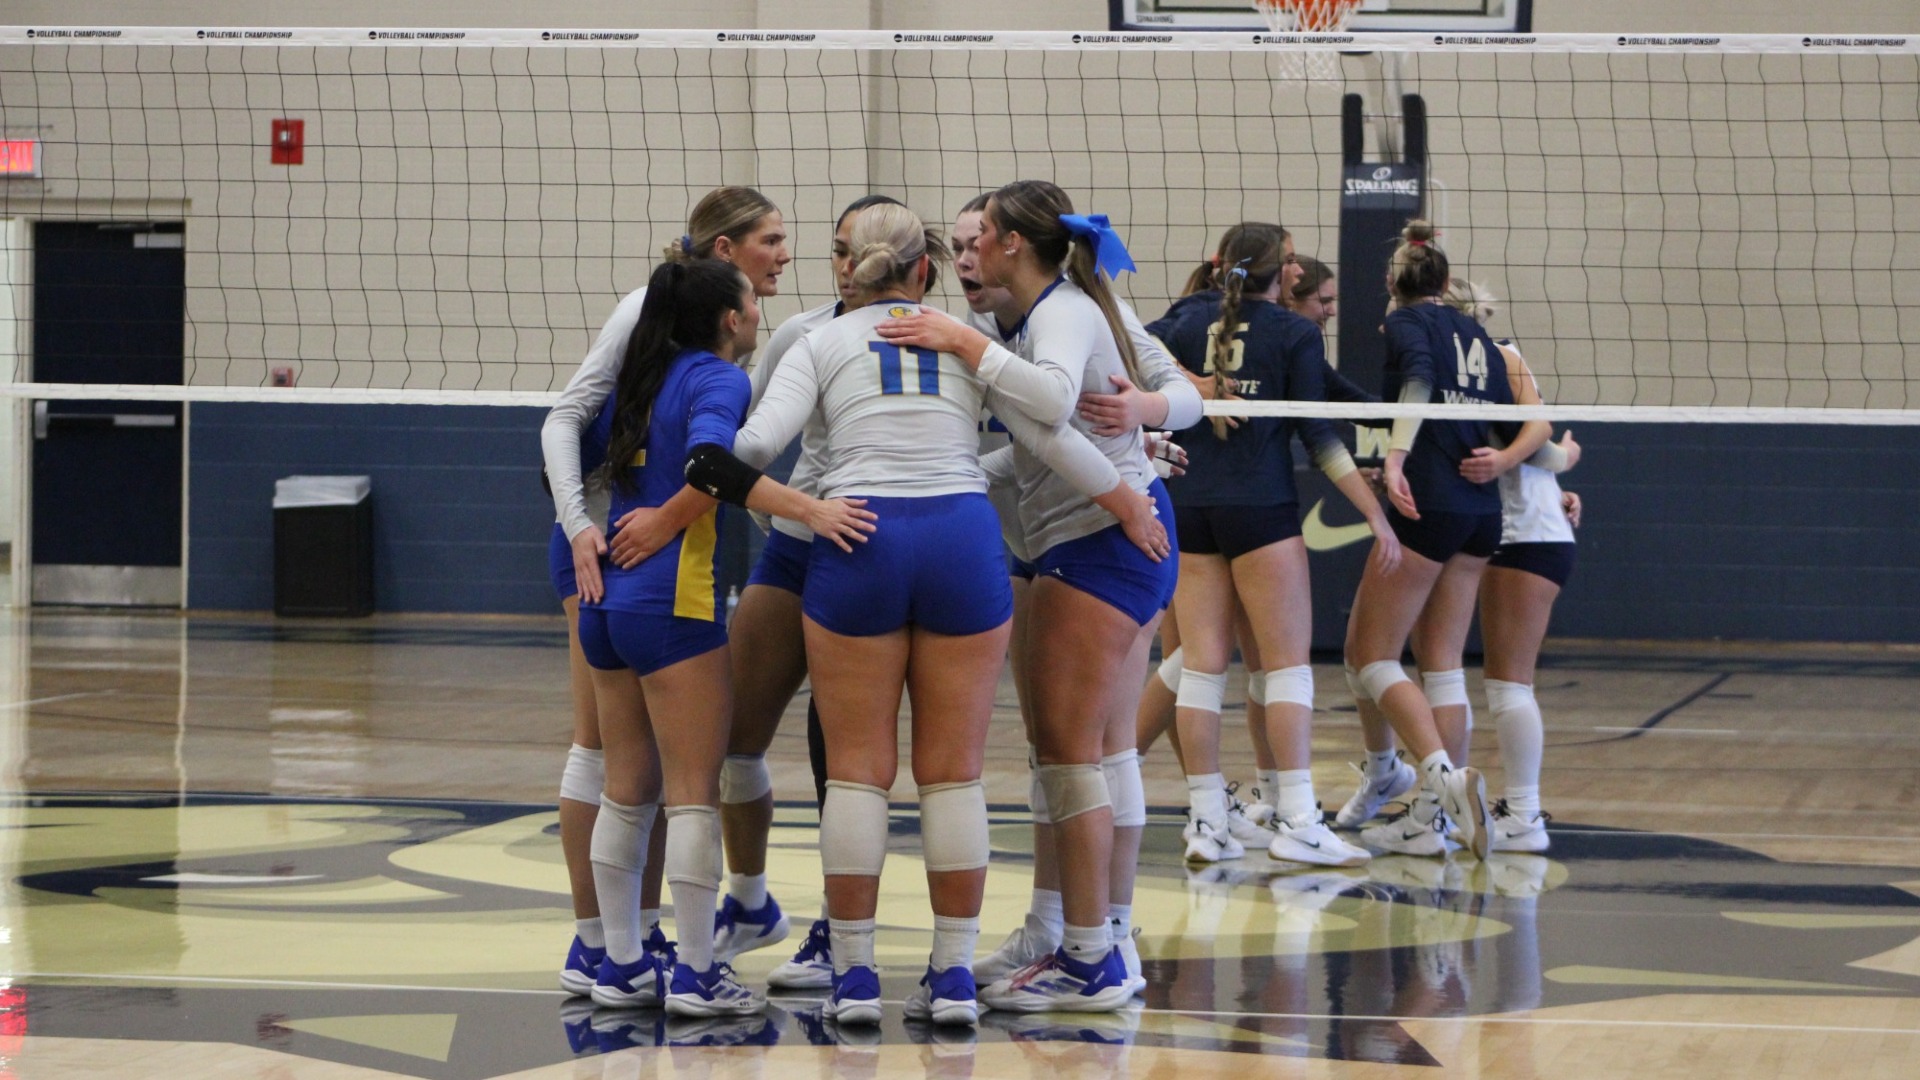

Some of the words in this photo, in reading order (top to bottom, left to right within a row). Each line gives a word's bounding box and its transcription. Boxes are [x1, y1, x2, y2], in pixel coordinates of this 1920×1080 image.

[36, 29, 72, 38] VOLLEYBALL
[74, 30, 121, 39] CHAMPIONSHIP
[206, 31, 242, 39] VOLLEYBALL
[245, 31, 292, 39] CHAMPIONSHIP
[379, 31, 414, 40] VOLLEYBALL
[417, 32, 465, 40] CHAMPIONSHIP
[552, 32, 589, 41] VOLLEYBALL
[590, 32, 639, 41] CHAMPIONSHIP
[728, 33, 764, 42] VOLLEYBALL
[766, 33, 815, 42] CHAMPIONSHIP
[904, 34, 941, 43] VOLLEYBALL
[943, 34, 993, 43] CHAMPIONSHIP
[1083, 35, 1120, 43] VOLLEYBALL
[1122, 35, 1172, 44] CHAMPIONSHIP
[1263, 35, 1300, 44] VOLLEYBALL
[1303, 36, 1354, 44] CHAMPIONSHIP
[1445, 36, 1483, 45] VOLLEYBALL
[1485, 36, 1536, 45] CHAMPIONSHIP
[1628, 37, 1667, 46] VOLLEYBALL
[1668, 37, 1720, 46] CHAMPIONSHIP
[1811, 38, 1852, 47] VOLLEYBALL
[1852, 38, 1906, 47] CHAMPIONSHIP
[1345, 179, 1419, 196] SPALDING
[1453, 332, 1488, 391] 14
[868, 341, 941, 396] 11
